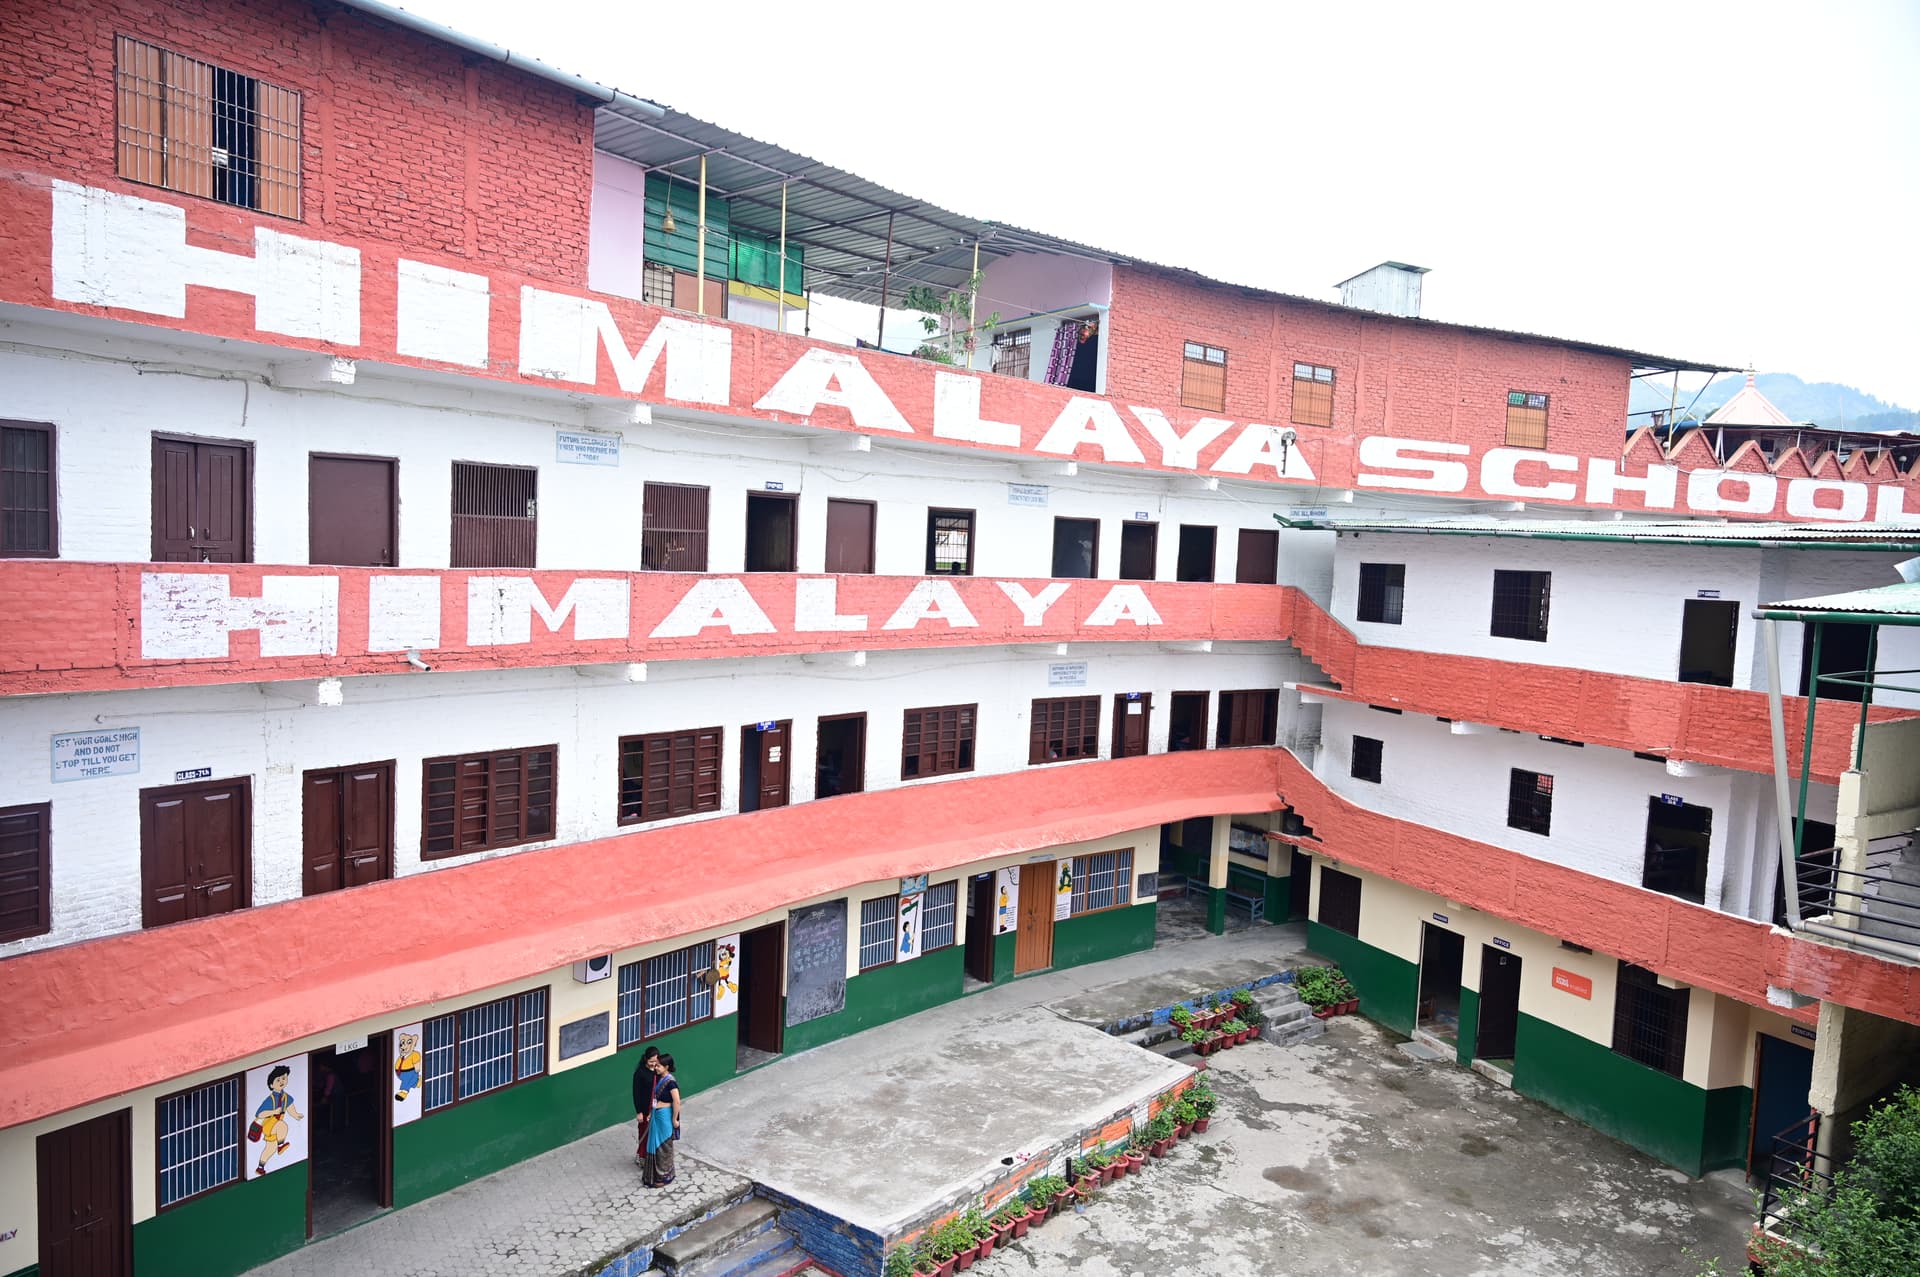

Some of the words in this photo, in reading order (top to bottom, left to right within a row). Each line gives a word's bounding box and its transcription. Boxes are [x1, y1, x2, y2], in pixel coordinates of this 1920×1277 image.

[51, 178, 1316, 481] HIMALAYA
[1356, 435, 1920, 523] SCHOOL
[141, 571, 1163, 660] HIMALAYA
[55, 738, 71, 748] SET
[72, 736, 93, 746] YOUR
[94, 734, 118, 744] GOALS
[119, 732, 137, 742] HIGH
[74, 747, 91, 757] AND
[93, 746, 104, 755] DO
[105, 744, 121, 753] NOT
[55, 759, 80, 770] STOP
[81, 756, 102, 766] TILL
[102, 755, 118, 764] YOU
[118, 753, 137, 762] GET
[1493, 938, 1510, 948] OFFICE
[343, 1040, 361, 1052] LKG
